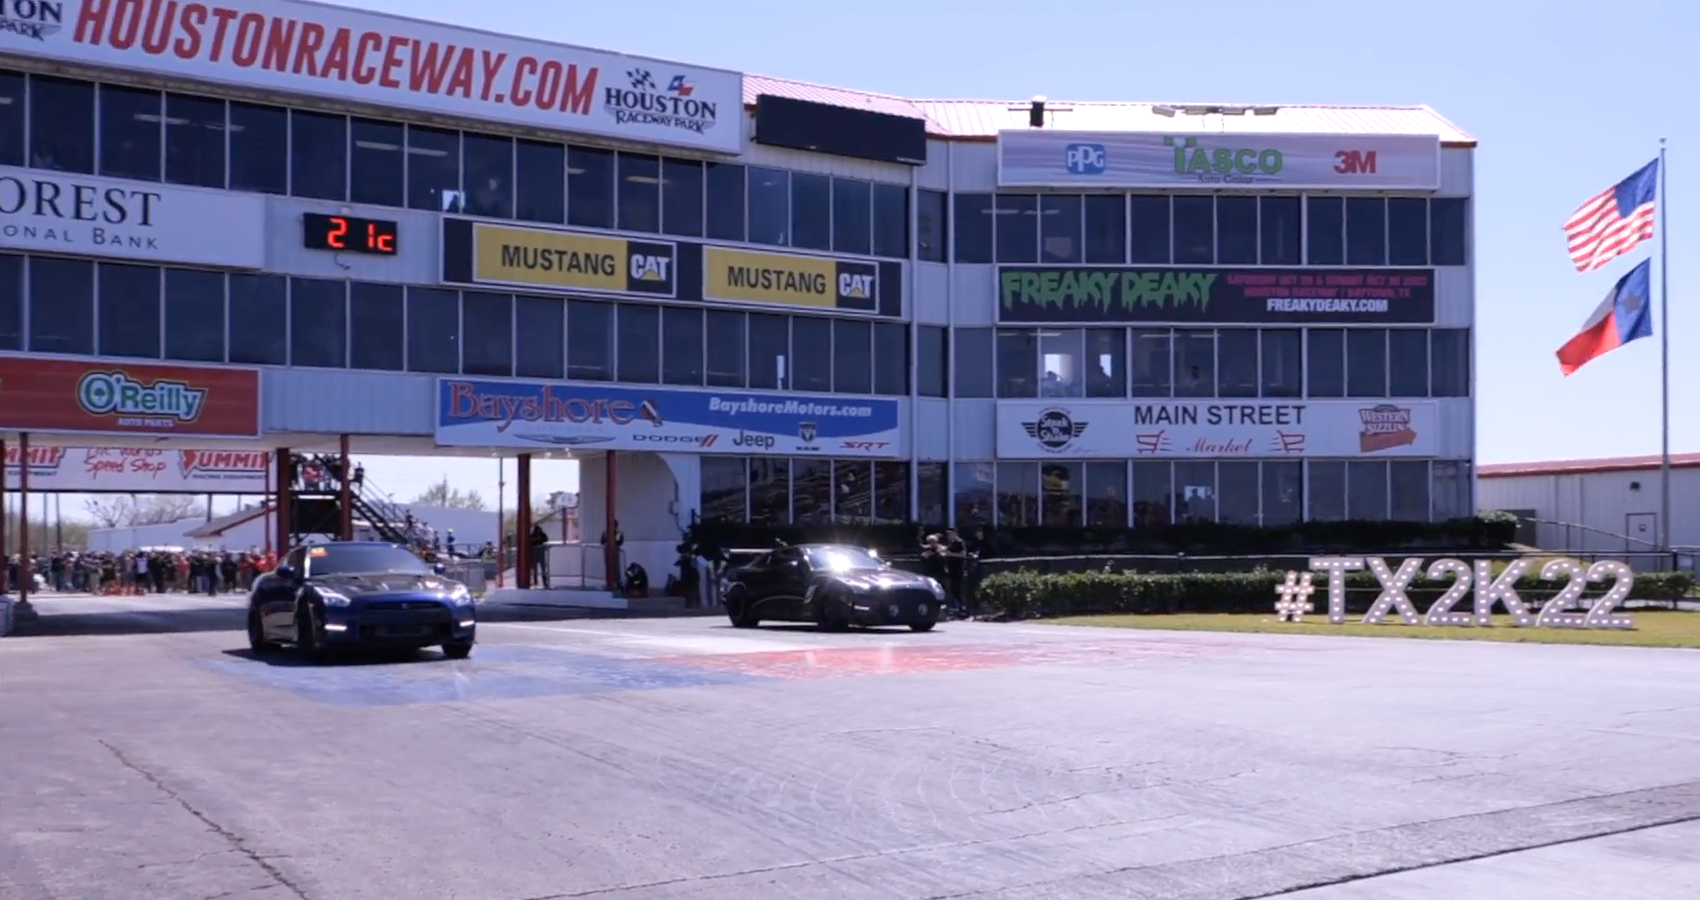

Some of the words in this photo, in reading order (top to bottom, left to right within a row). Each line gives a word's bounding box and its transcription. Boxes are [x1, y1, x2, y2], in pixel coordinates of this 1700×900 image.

[73, 0, 598, 115] HOUSTONRACEWAY.COM
[605, 87, 717, 120] HOUSTON
[616, 109, 672, 127] RACEWAY
[674, 116, 705, 135] PARK
[1066, 145, 1104, 172] PPG
[1163, 135, 1283, 175] TASCO
[1333, 150, 1377, 174] 3M
[0, 176, 161, 226] OREST
[501, 243, 615, 277] MUSTANG
[629, 252, 672, 282] CAT
[727, 265, 827, 295] MUSTANG
[838, 272, 875, 299] CAT
[1001, 271, 1119, 314] FREAKY
[1121, 271, 1218, 314] DEAKY
[1266, 298, 1389, 312] FREAKYDEAKY.COM
[82, 374, 201, 419] O'Reilly
[449, 381, 636, 433] Bayshore
[709, 397, 873, 417] BayshoreMotors.com
[1134, 405, 1198, 425] MAIN
[1207, 405, 1306, 426] STREET
[732, 430, 775, 449] Jeep
[839, 441, 891, 451] SRT
[1186, 437, 1254, 454] Market
[84, 457, 128, 480] Speed
[130, 458, 167, 479] Shop
[1274, 556, 1635, 629] #TX2K22
